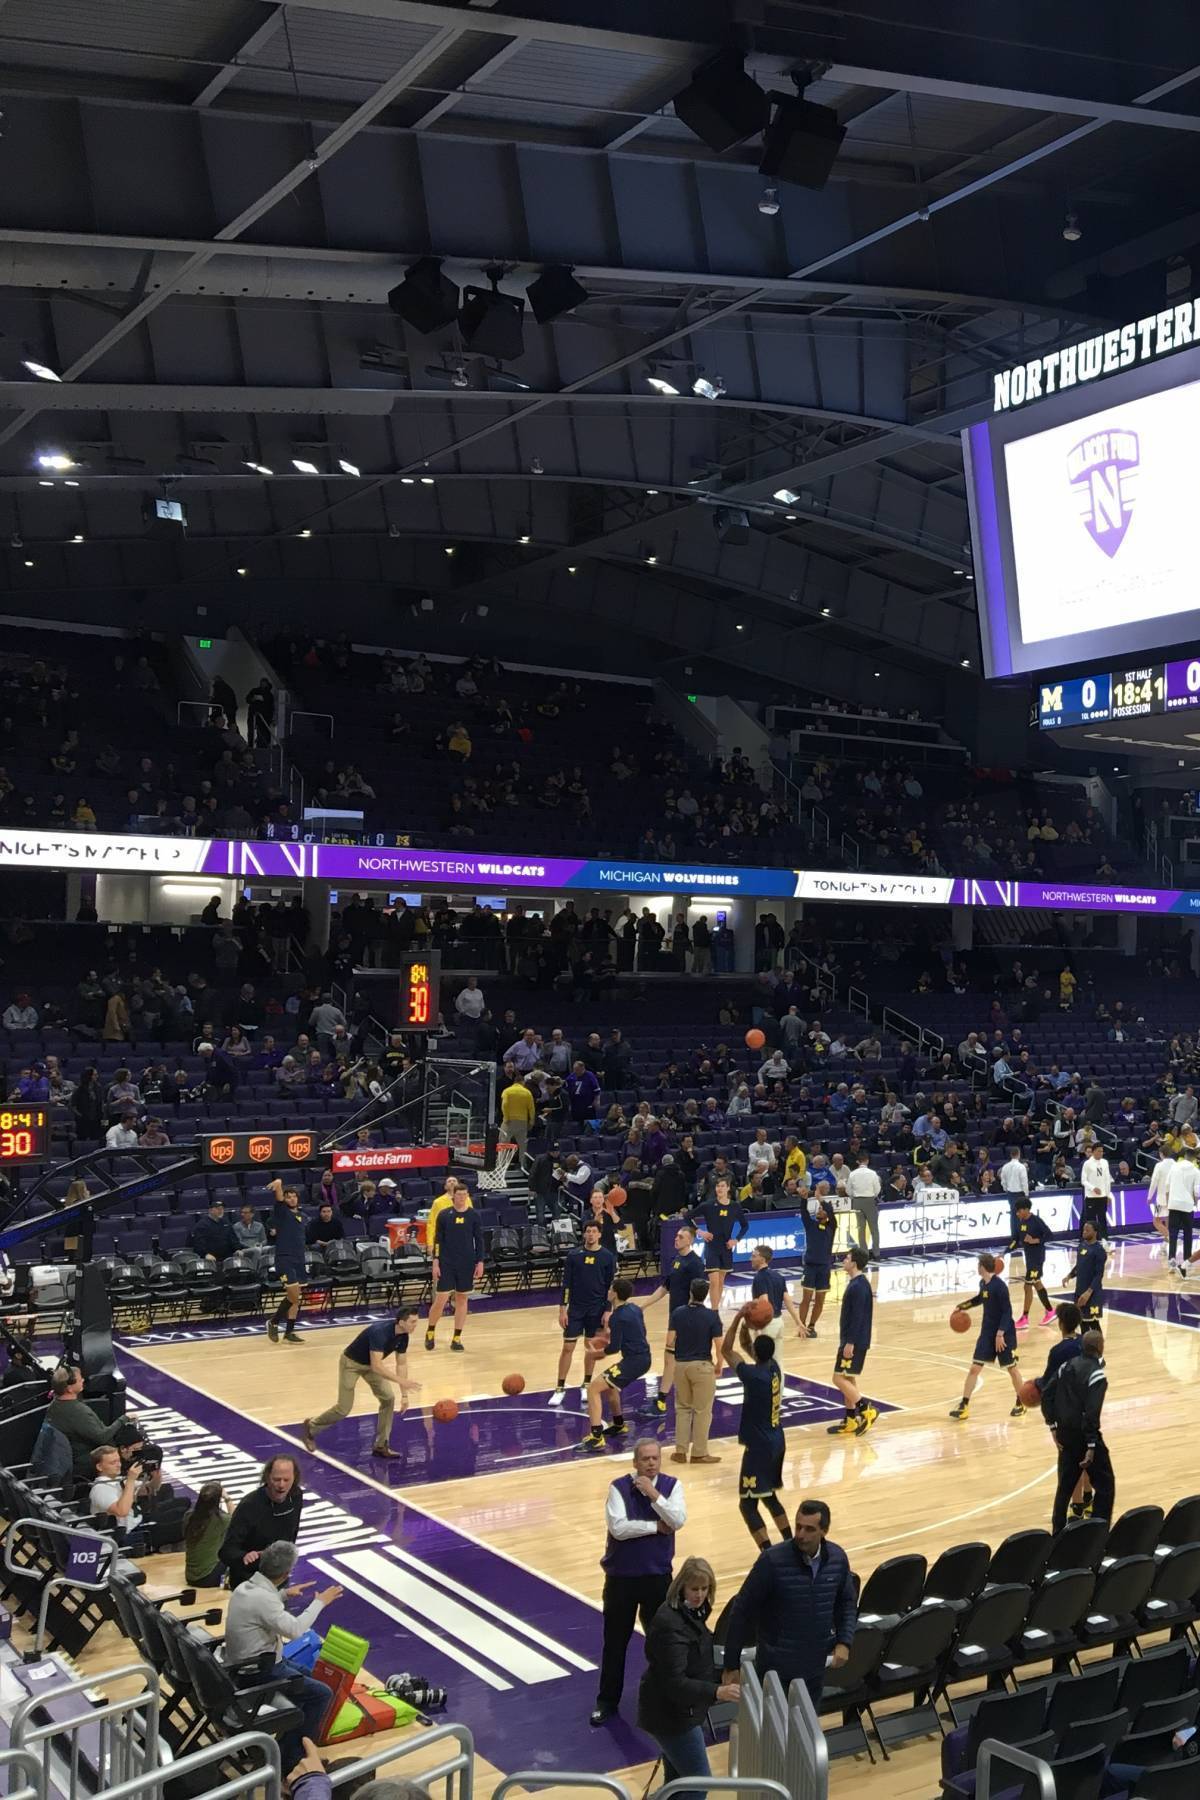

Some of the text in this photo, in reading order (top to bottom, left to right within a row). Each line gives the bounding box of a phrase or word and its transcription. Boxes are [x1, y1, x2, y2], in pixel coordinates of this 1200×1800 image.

[1136, 668, 1153, 680] HALF
[1082, 679, 1097, 708] 0
[1114, 676, 1164, 706] 18:41
[1041, 685, 1063, 713] M
[1113, 703, 1151, 717] POSSESSION
[358, 857, 545, 876] NORTHWESTERN WILDCATS
[599, 870, 739, 885] MICHIGAN WOLVERINES
[1042, 891, 1157, 904] NORTHWESTERN WILDCATS
[1, 1132, 31, 1156] 30
[212, 1144, 234, 1159] ups
[250, 1143, 271, 1157] ups
[289, 1142, 309, 1156] ups
[123, 1313, 388, 1343] WINTUST
[72, 1551, 98, 1564] 103
